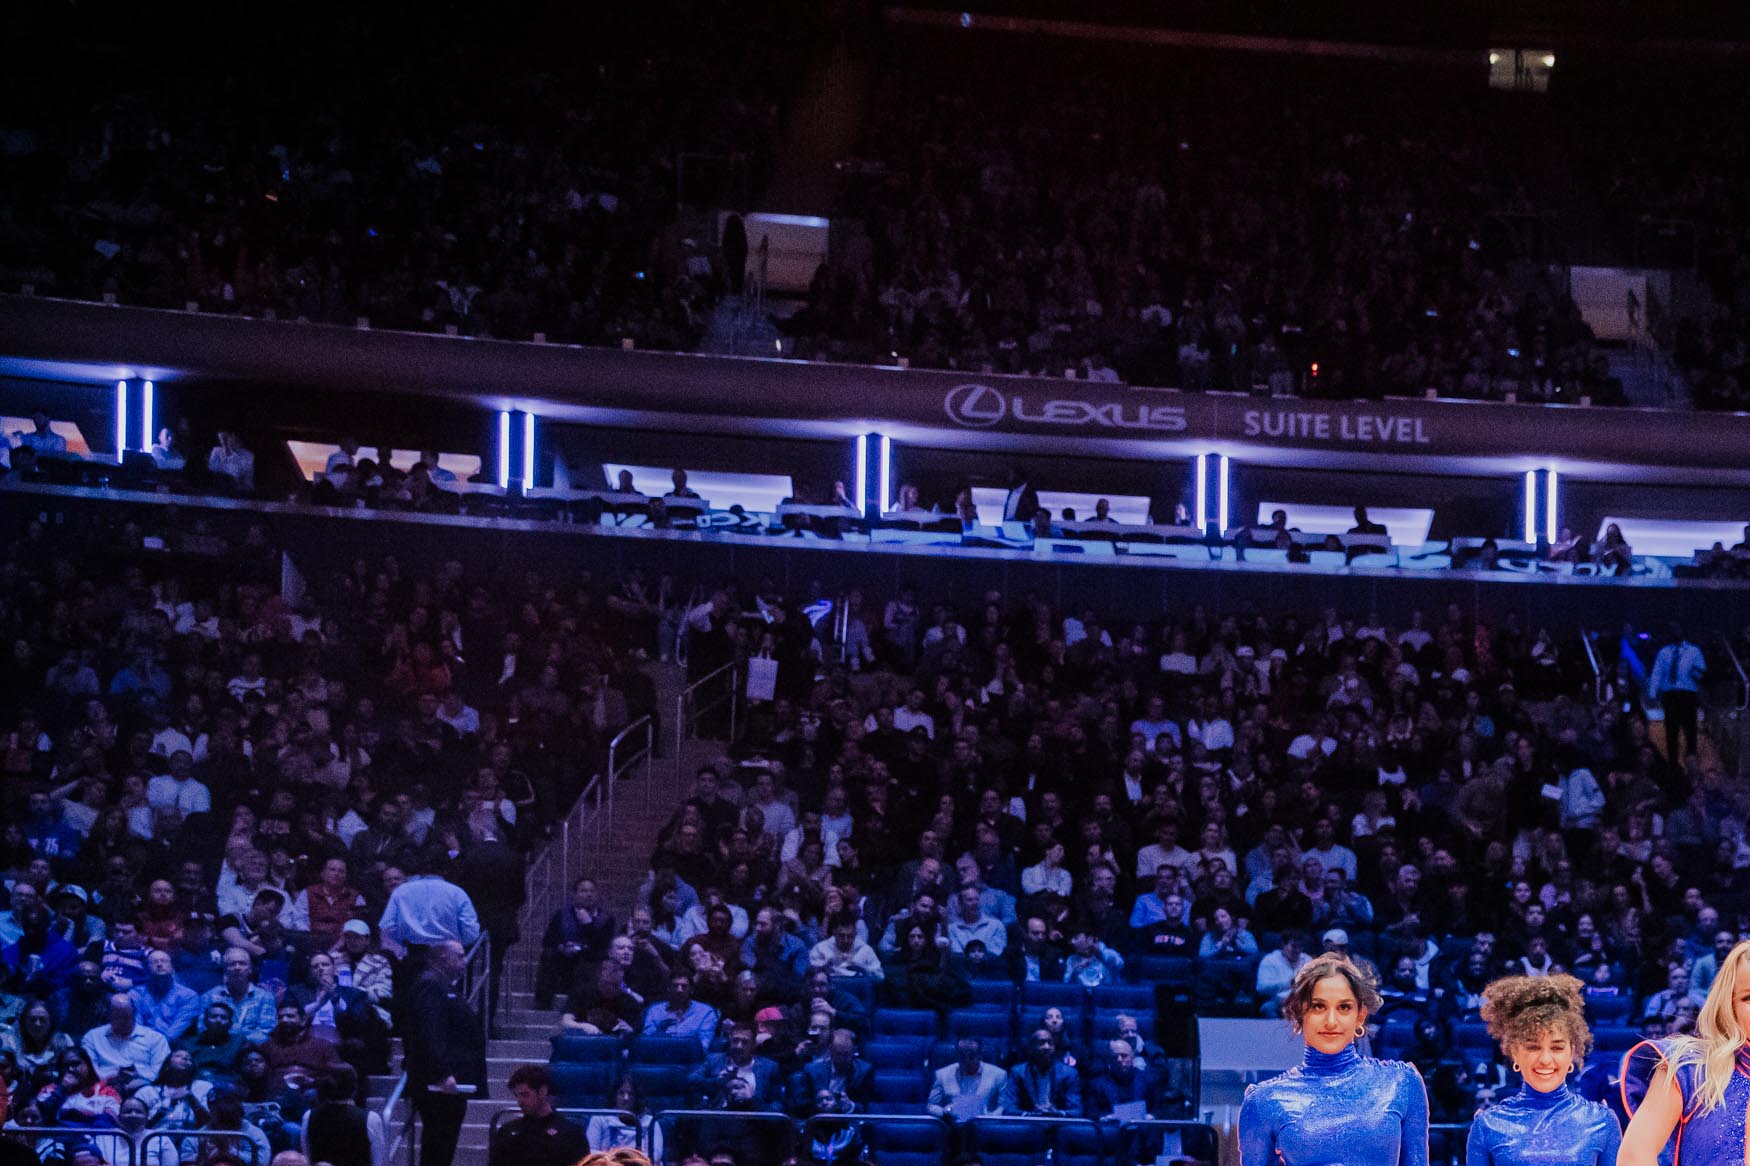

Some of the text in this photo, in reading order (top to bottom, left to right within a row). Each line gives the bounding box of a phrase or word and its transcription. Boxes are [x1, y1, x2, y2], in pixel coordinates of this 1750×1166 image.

[1012, 399, 1187, 431] LEXUS
[1244, 410, 1430, 444] SUITE LEVEL
